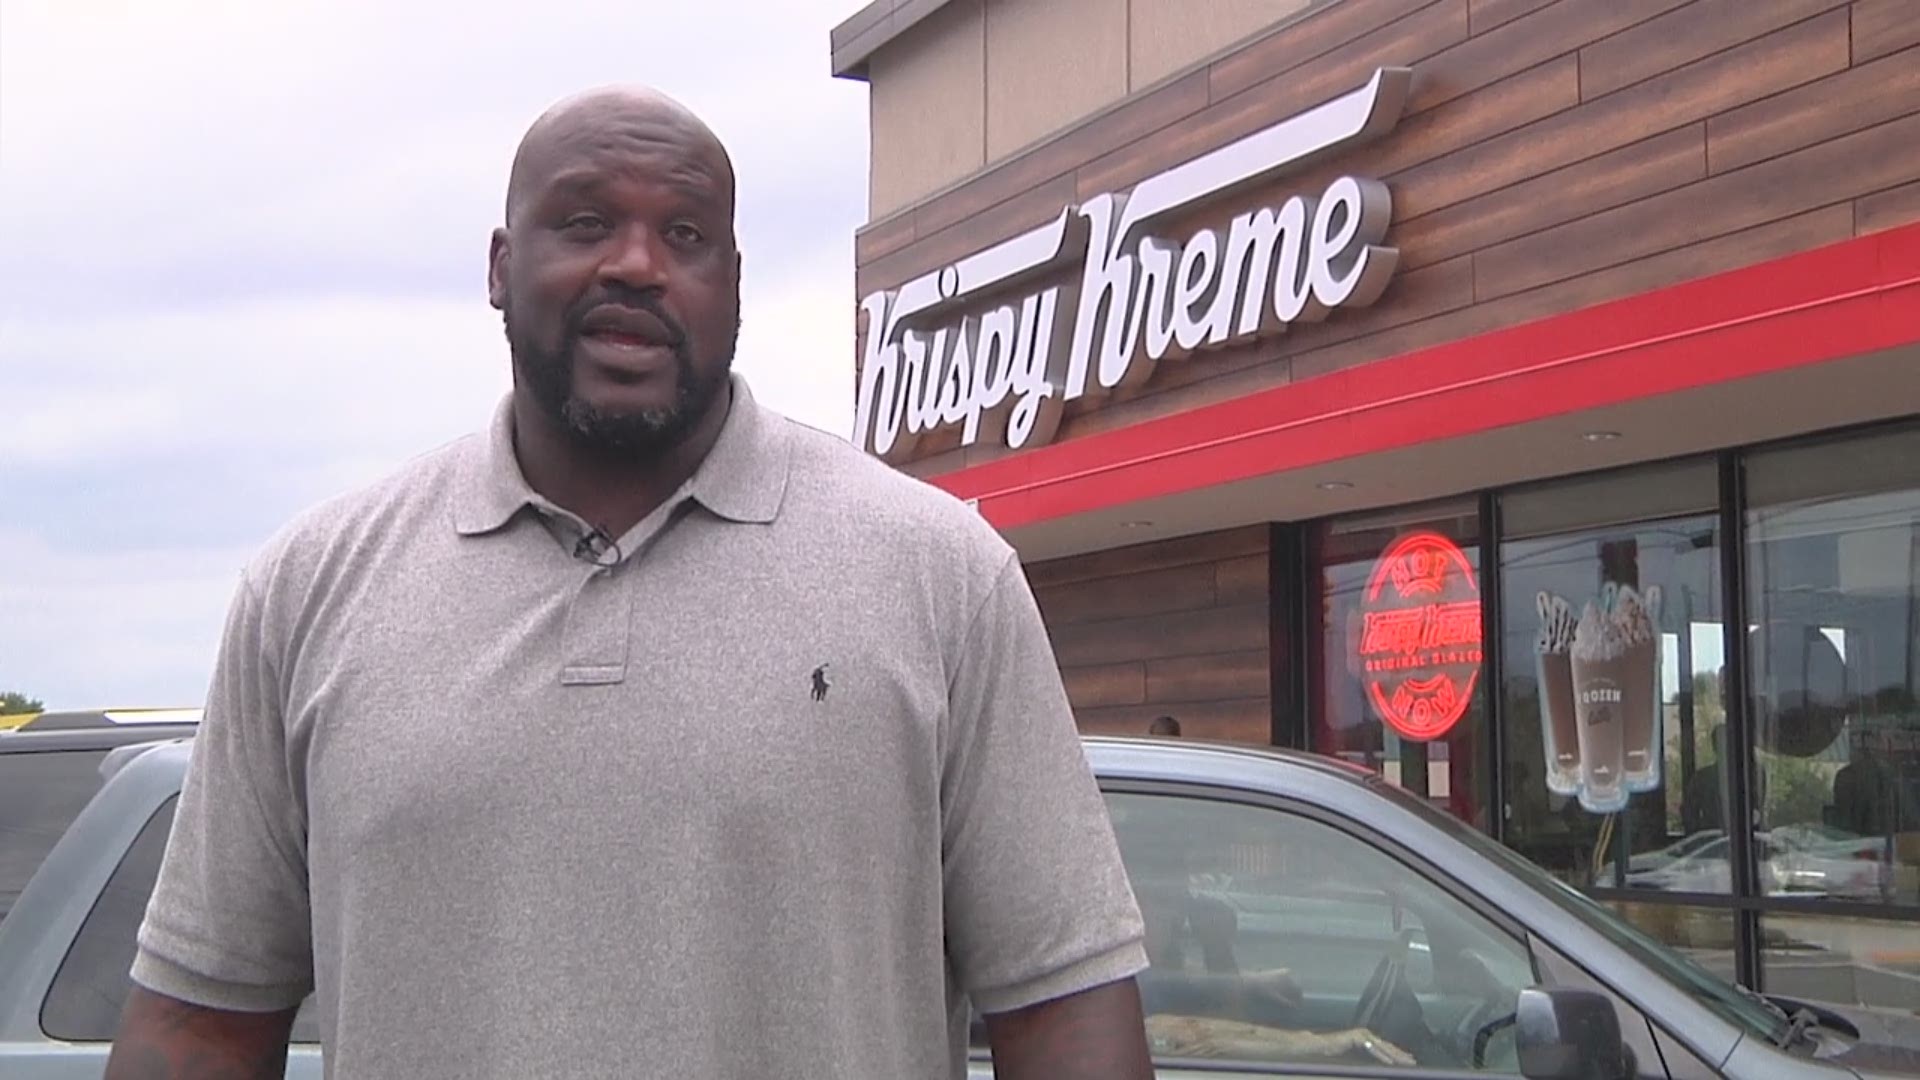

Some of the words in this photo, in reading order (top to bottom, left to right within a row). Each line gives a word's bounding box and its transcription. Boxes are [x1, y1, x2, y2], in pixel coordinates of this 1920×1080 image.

[853, 205, 1067, 455] Krispy
[1064, 68, 1383, 400] Kreme
[1392, 548, 1448, 592] HOT
[1393, 682, 1455, 726] NOW
